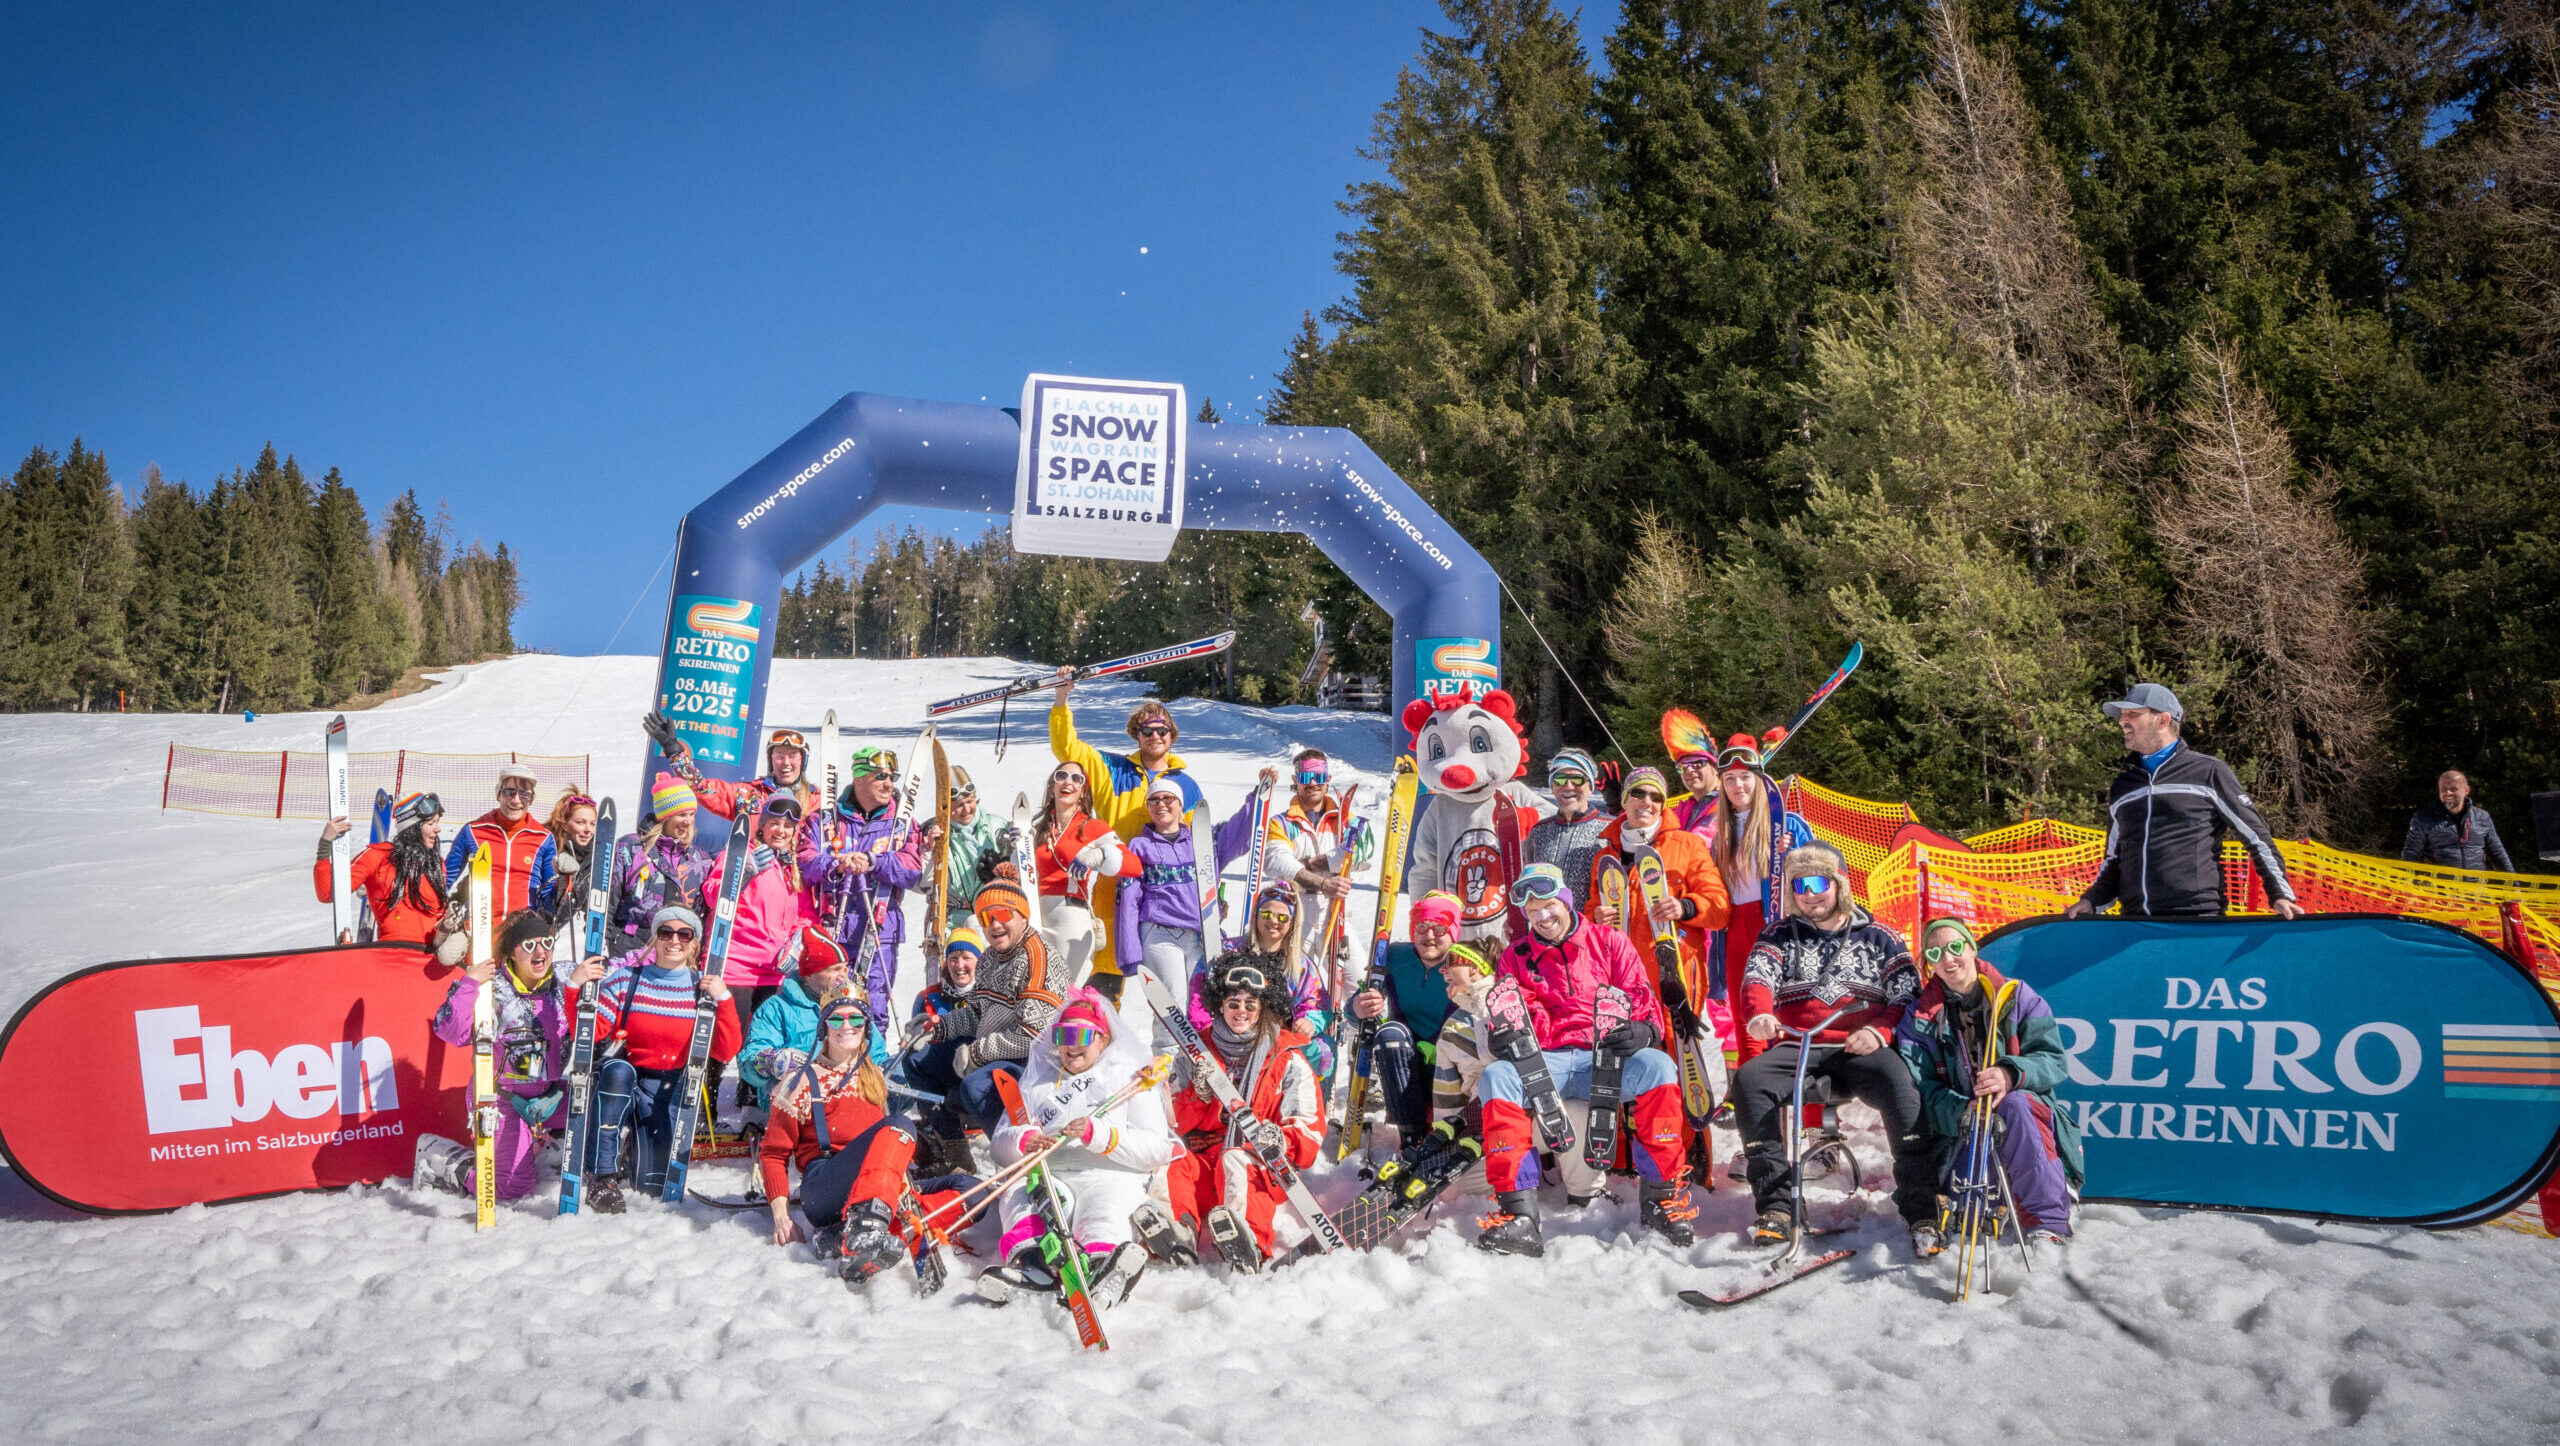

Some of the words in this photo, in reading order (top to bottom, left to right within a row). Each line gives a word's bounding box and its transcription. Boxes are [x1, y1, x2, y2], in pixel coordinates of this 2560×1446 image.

[1053, 398, 1158, 416] FLACHAU
[1051, 413, 1158, 442] SNOW
[1051, 440, 1157, 459] WAGRAIN
[737, 437, 856, 530] snow-space.com
[1048, 456, 1156, 486] SPACE
[1047, 484, 1070, 498] ST.
[1074, 485, 1155, 503] JOHANN
[1046, 505, 1153, 522] SALZBURG
[1345, 468, 1453, 570] snow-space.com
[674, 637, 750, 663] RETRO
[701, 629, 725, 640] DAS
[678, 658, 741, 674] SKIRENNEN
[1129, 647, 1189, 666] BLIZZARD
[675, 677, 737, 698] 08.Mär
[1452, 669, 1473, 678] DAS
[672, 692, 735, 718] 2025
[688, 721, 710, 735] THE
[711, 724, 739, 739] DATE
[826, 763, 837, 808] ATOMIC
[902, 773, 921, 818] ATOMIC
[1024, 836, 1032, 862] ATOMIC
[1250, 829, 1263, 893] BLIZZARD
[1395, 816, 1409, 874] ATOMIC
[600, 842, 612, 891] ATOMIC
[729, 856, 743, 902] ATOMIC
[1769, 874, 1781, 913] ARC
[2163, 977, 2267, 1010] DAS
[1166, 1005, 1198, 1043] ATOMIC
[134, 1004, 400, 1135] Eben
[2056, 1017, 2423, 1096] RETRO
[151, 1139, 219, 1162] Mitten
[225, 1138, 250, 1154] im
[256, 1120, 404, 1152] Salzburgerland
[485, 1158, 493, 1209] ATOMIC
[1072, 1302, 1094, 1343] ATOMIC
